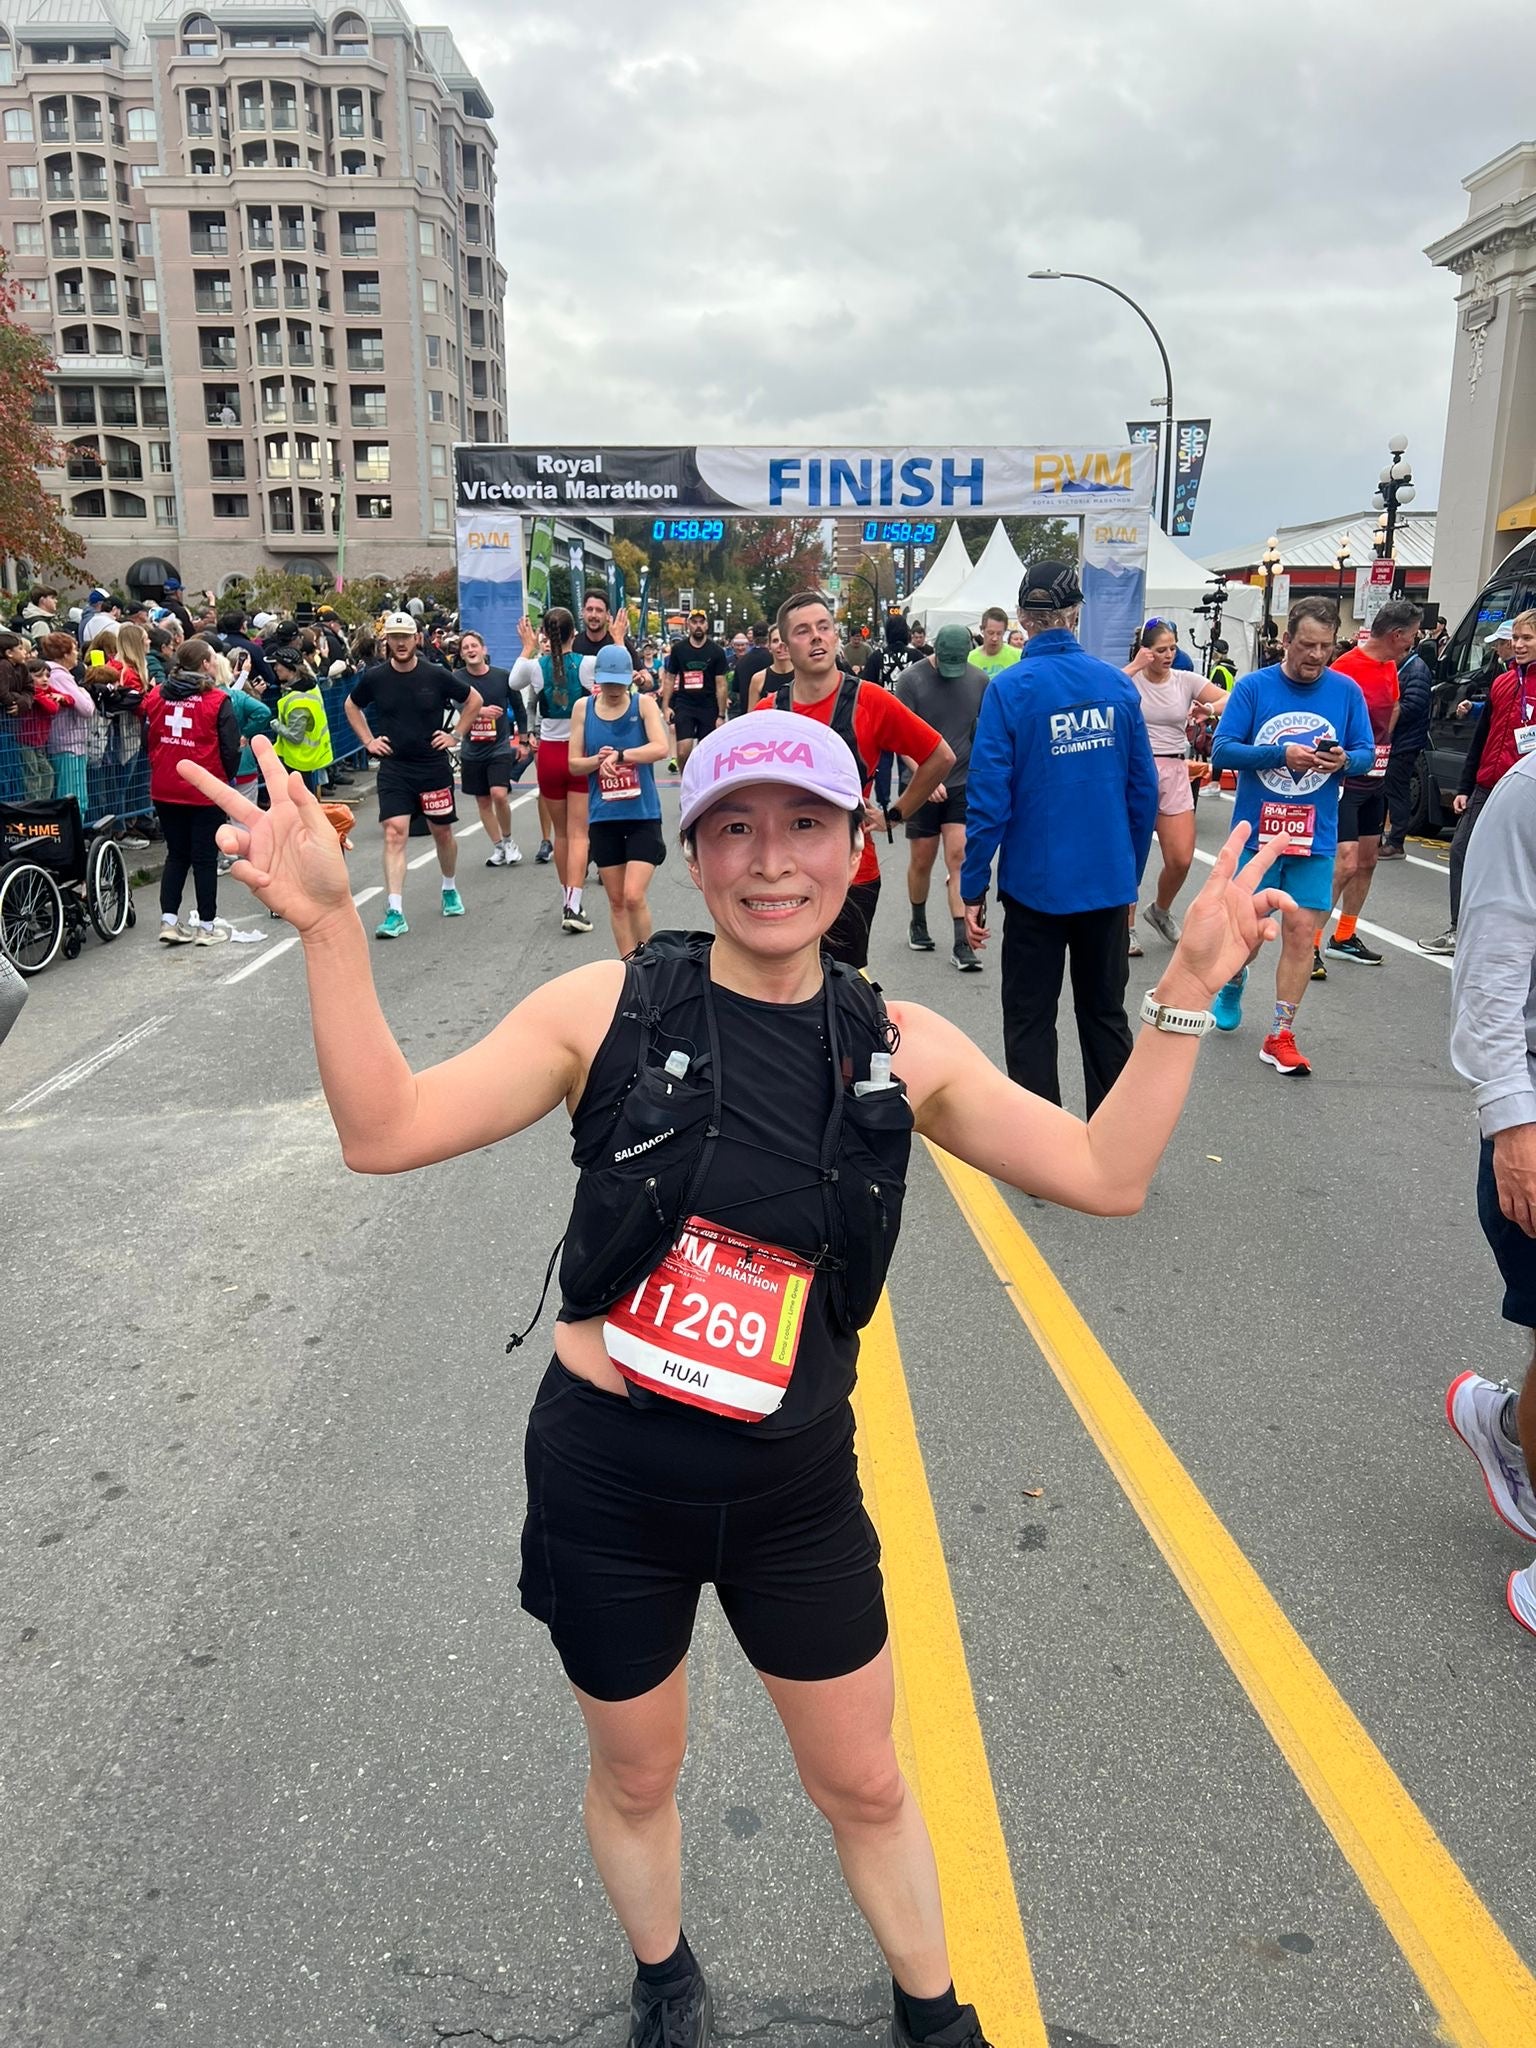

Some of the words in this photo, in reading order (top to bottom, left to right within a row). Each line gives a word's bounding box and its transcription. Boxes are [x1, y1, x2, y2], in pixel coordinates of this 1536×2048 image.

[1191, 427, 1204, 458] OUR
[536, 455, 602, 478] Royal
[1032, 452, 1133, 495] RVM
[462, 481, 558, 500] Victoria
[565, 480, 678, 499] Marathon
[769, 457, 984, 508] FINISH
[467, 532, 511, 549] RVM
[1094, 527, 1138, 544] RVM
[1050, 706, 1115, 741] RVM
[1260, 714, 1320, 740] TORONTO
[1051, 737, 1116, 757] COMMITTE
[713, 740, 815, 782] HOKA
[600, 777, 632, 790] 10311
[1260, 767, 1292, 792] LUE
[1299, 774, 1323, 792] JA
[28, 824, 60, 836] HME
[1264, 819, 1305, 834] 10109
[613, 1127, 675, 1163] SALOMON
[672, 1231, 718, 1273] VM
[714, 1262, 779, 1294] MARATHON
[736, 1257, 766, 1275] HALF
[791, 1279, 801, 1299] Green
[628, 1273, 768, 1359] 11269
[662, 1359, 710, 1389] HUAI
